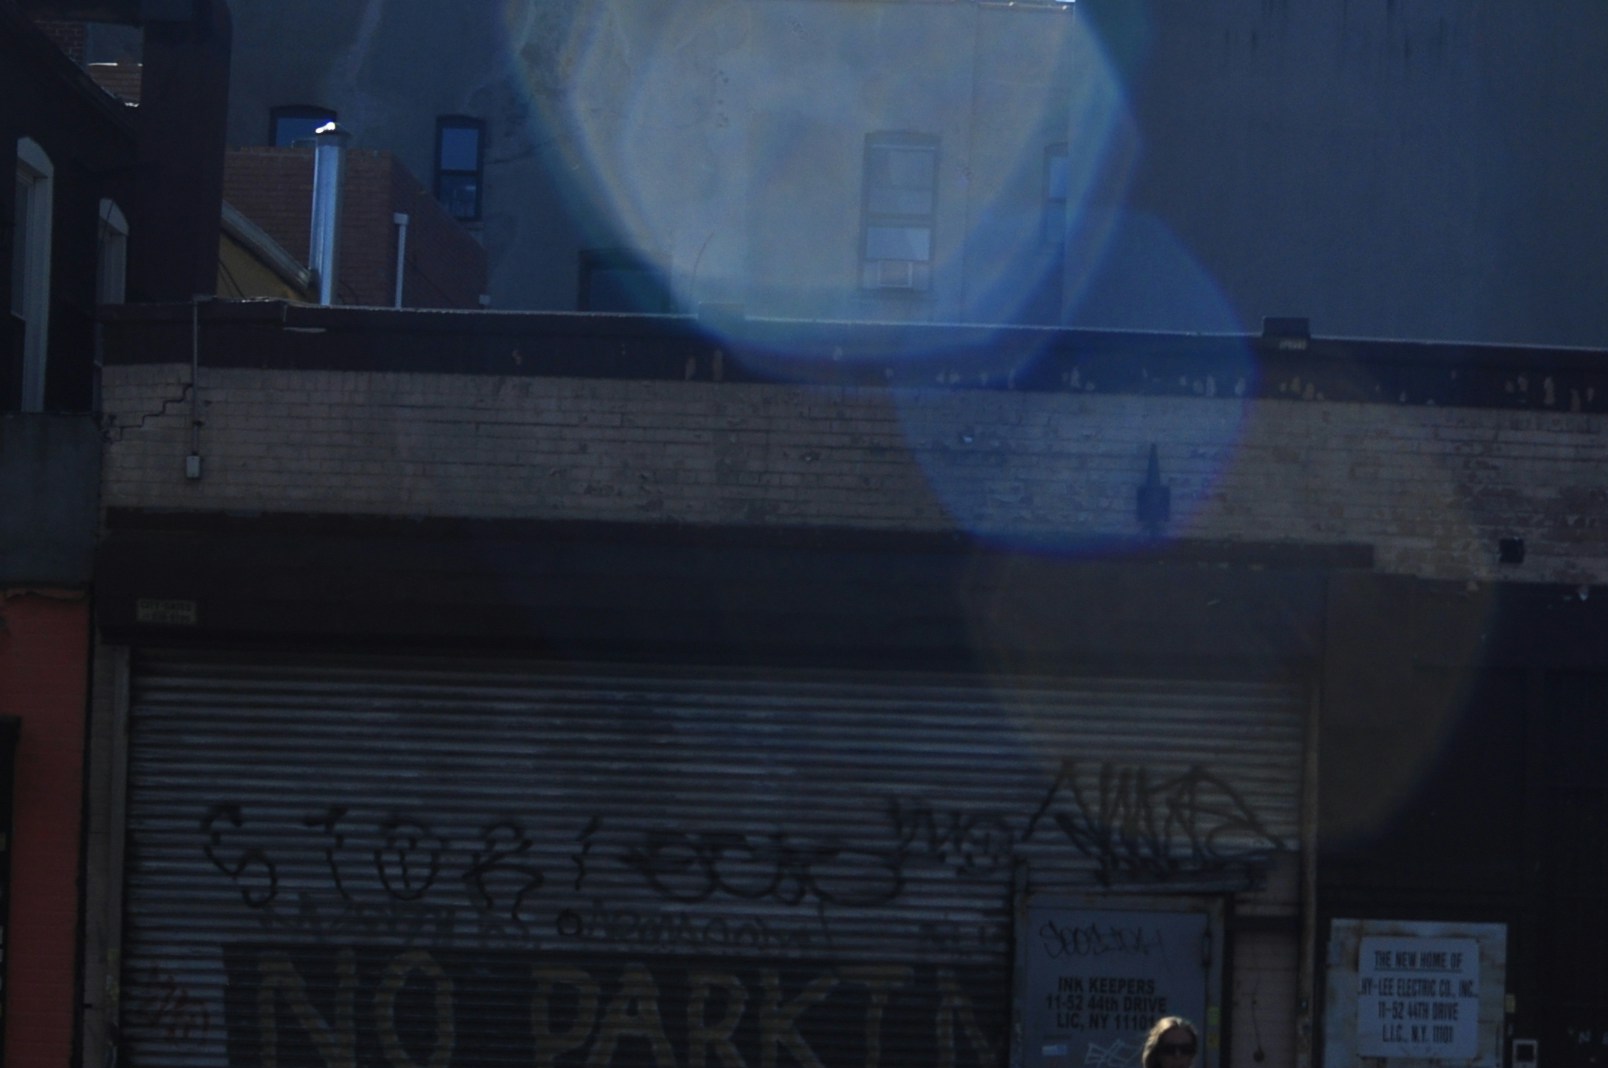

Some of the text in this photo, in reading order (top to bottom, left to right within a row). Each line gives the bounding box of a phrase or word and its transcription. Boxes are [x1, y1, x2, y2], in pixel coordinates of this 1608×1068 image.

[1374, 950, 1462, 969] THE NEW HOME OF
[1058, 976, 1155, 995] INK KEEPERS
[1397, 978, 1437, 997] ELECTRIC
[1047, 994, 1168, 1014] 11-52 44th DRIVE
[1378, 1001, 1458, 1020] 11-52 44TH DRIVE
[1089, 1014, 1109, 1029] NY
